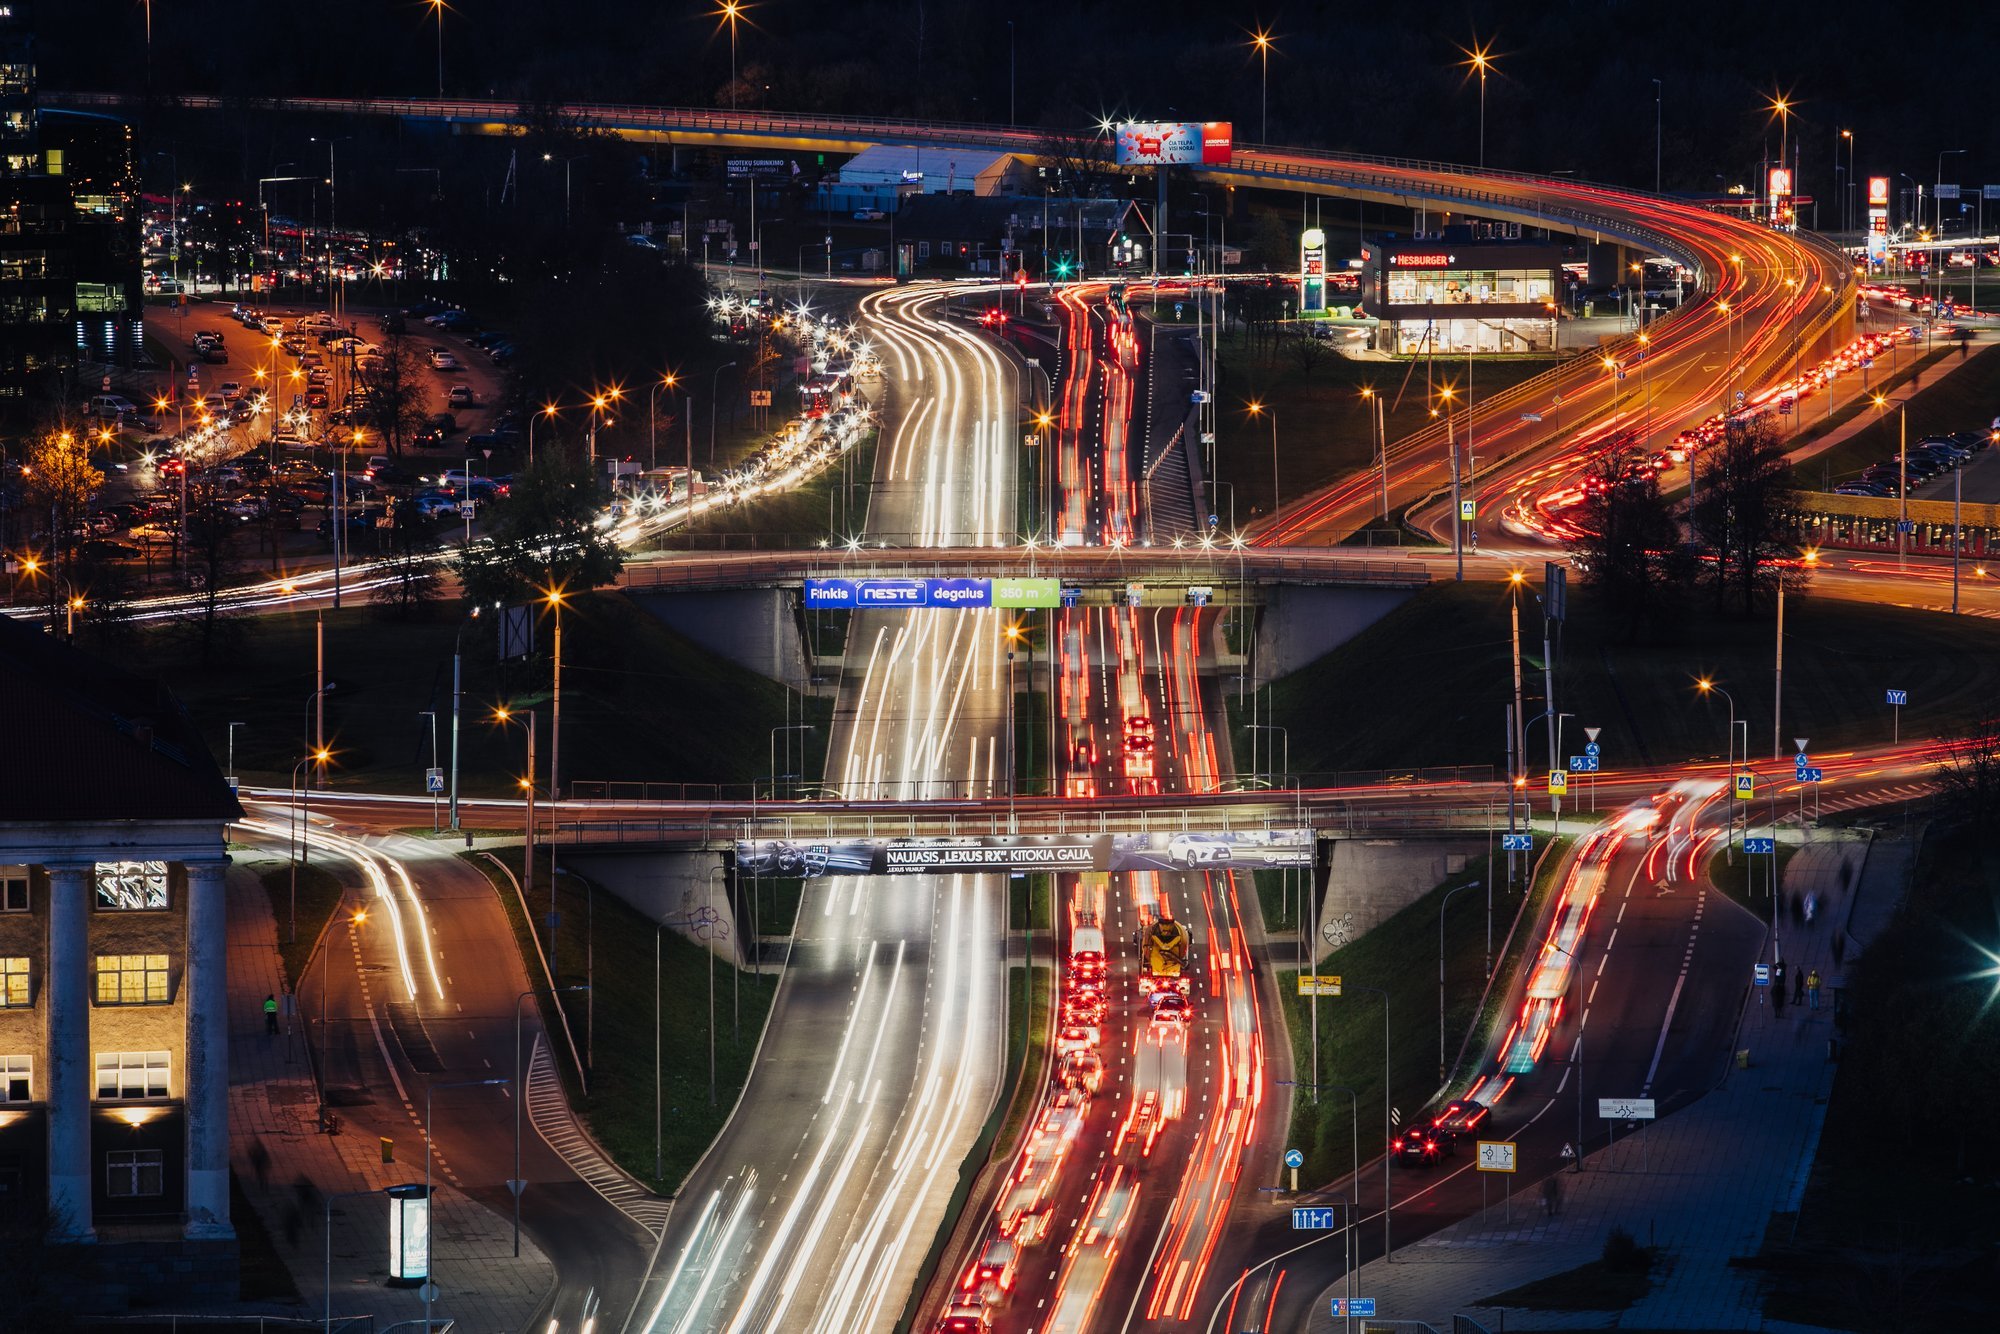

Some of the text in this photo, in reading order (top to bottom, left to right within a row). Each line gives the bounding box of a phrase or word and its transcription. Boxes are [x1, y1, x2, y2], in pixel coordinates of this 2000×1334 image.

[1397, 255, 1447, 265] HESBURGER
[810, 587, 1039, 602] Rinkis NESTE degalus 350 m
[887, 851, 939, 863] NAUJASIS
[1010, 849, 1055, 861] KITOKIA
[1057, 848, 1094, 860] GALIA.
